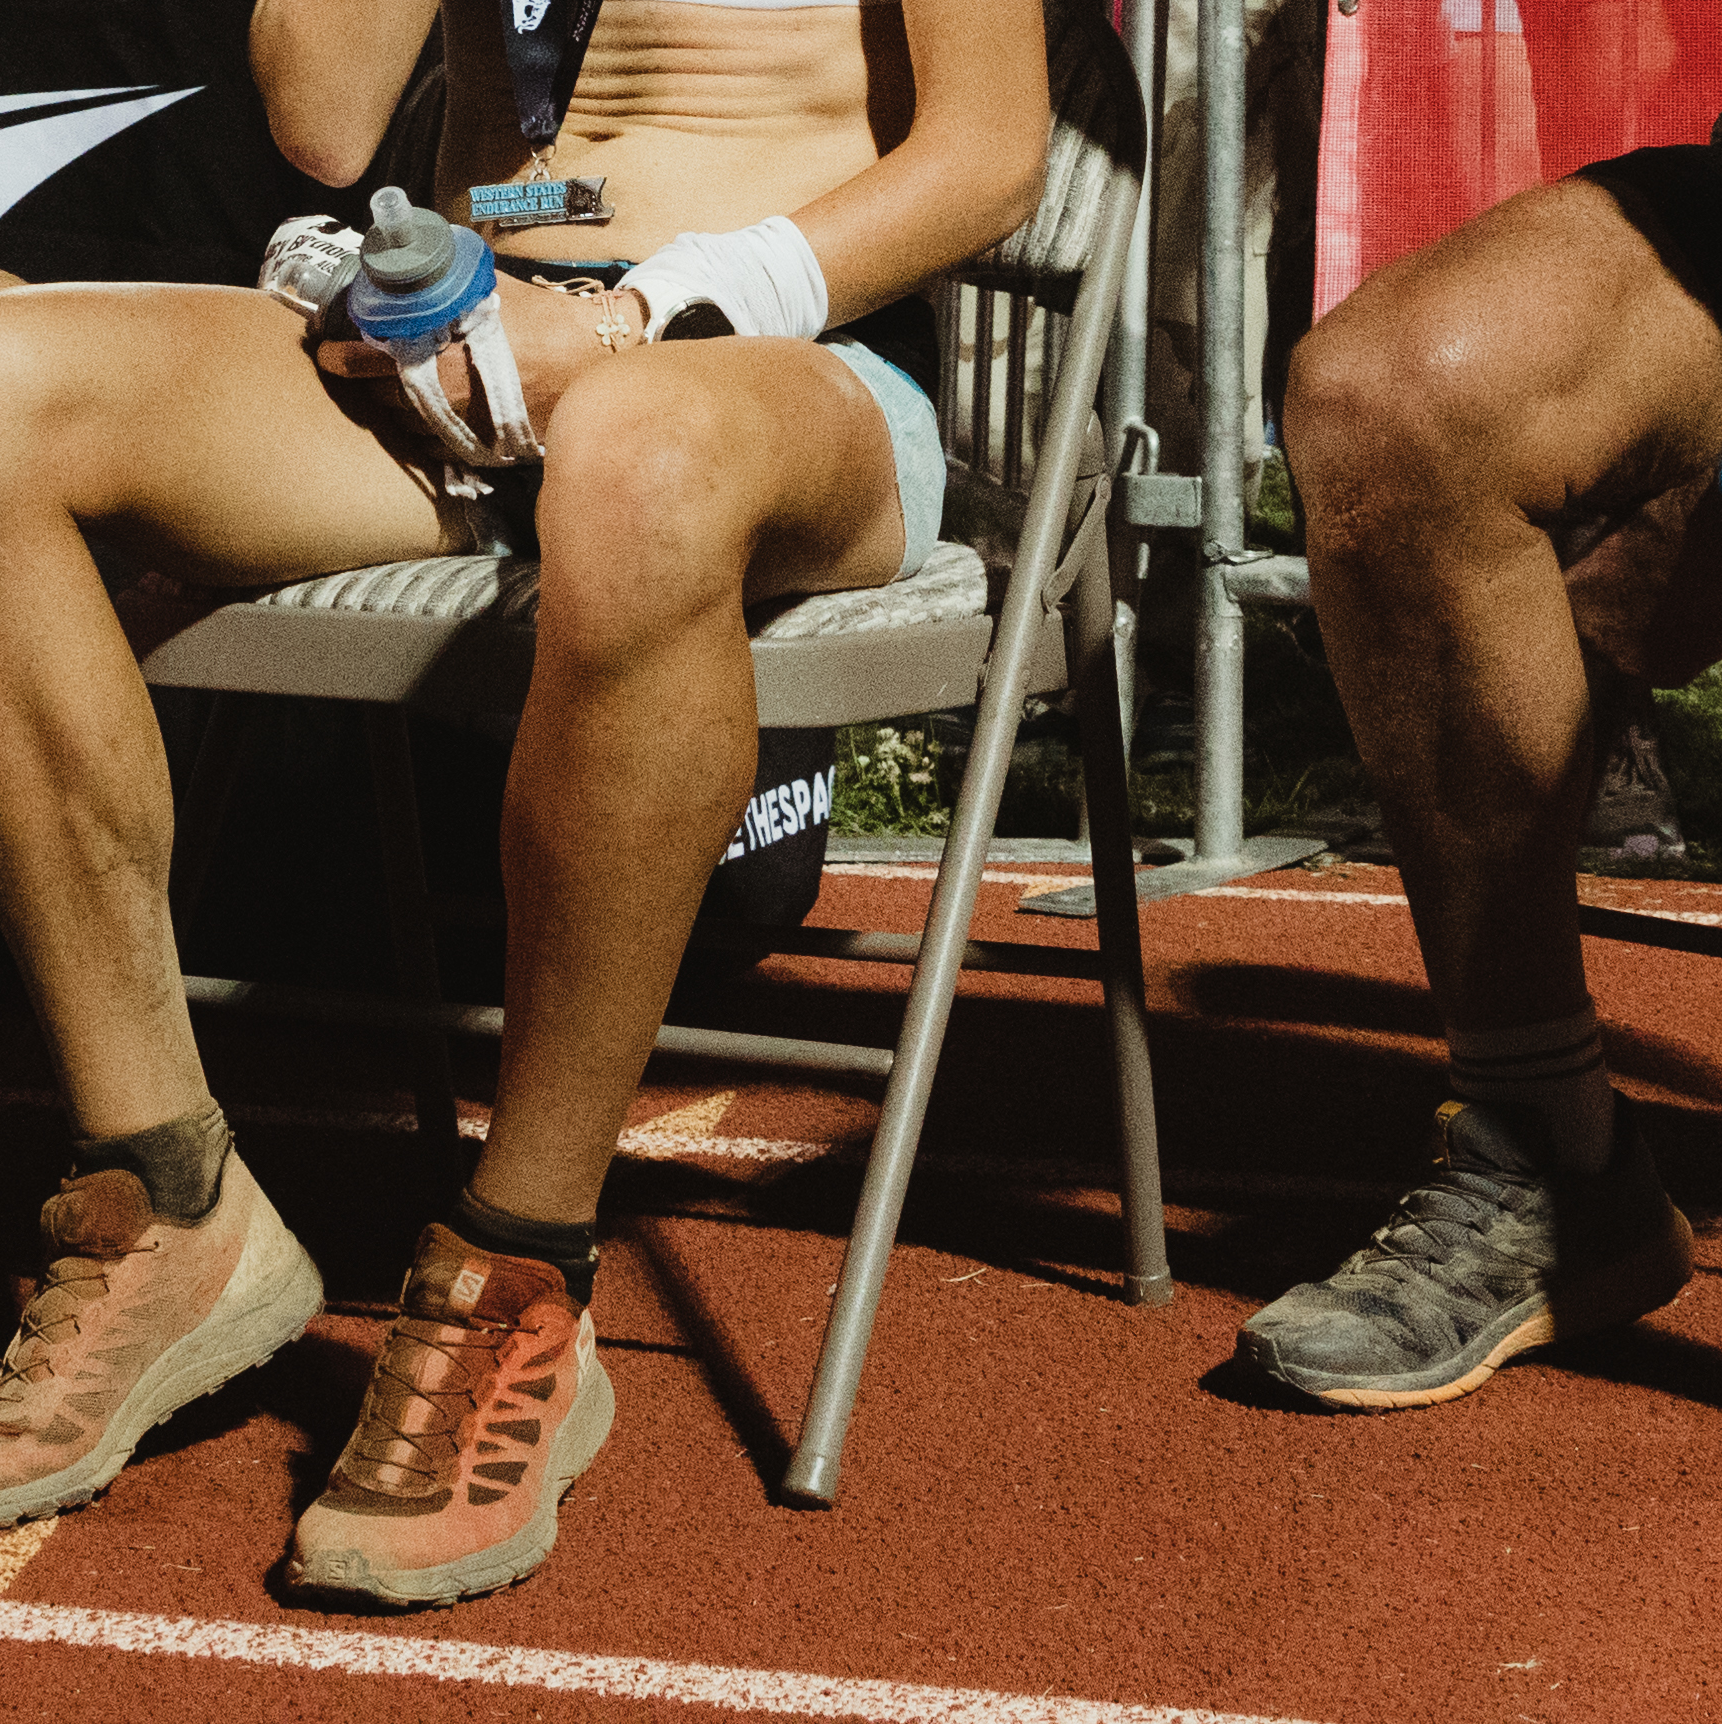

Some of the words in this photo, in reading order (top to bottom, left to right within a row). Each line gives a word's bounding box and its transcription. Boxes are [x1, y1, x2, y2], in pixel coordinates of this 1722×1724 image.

[469, 184, 524, 202] WESTERN
[525, 180, 567, 197] STATES
[471, 197, 538, 217] ENDURANCE
[540, 193, 565, 210] RUN
